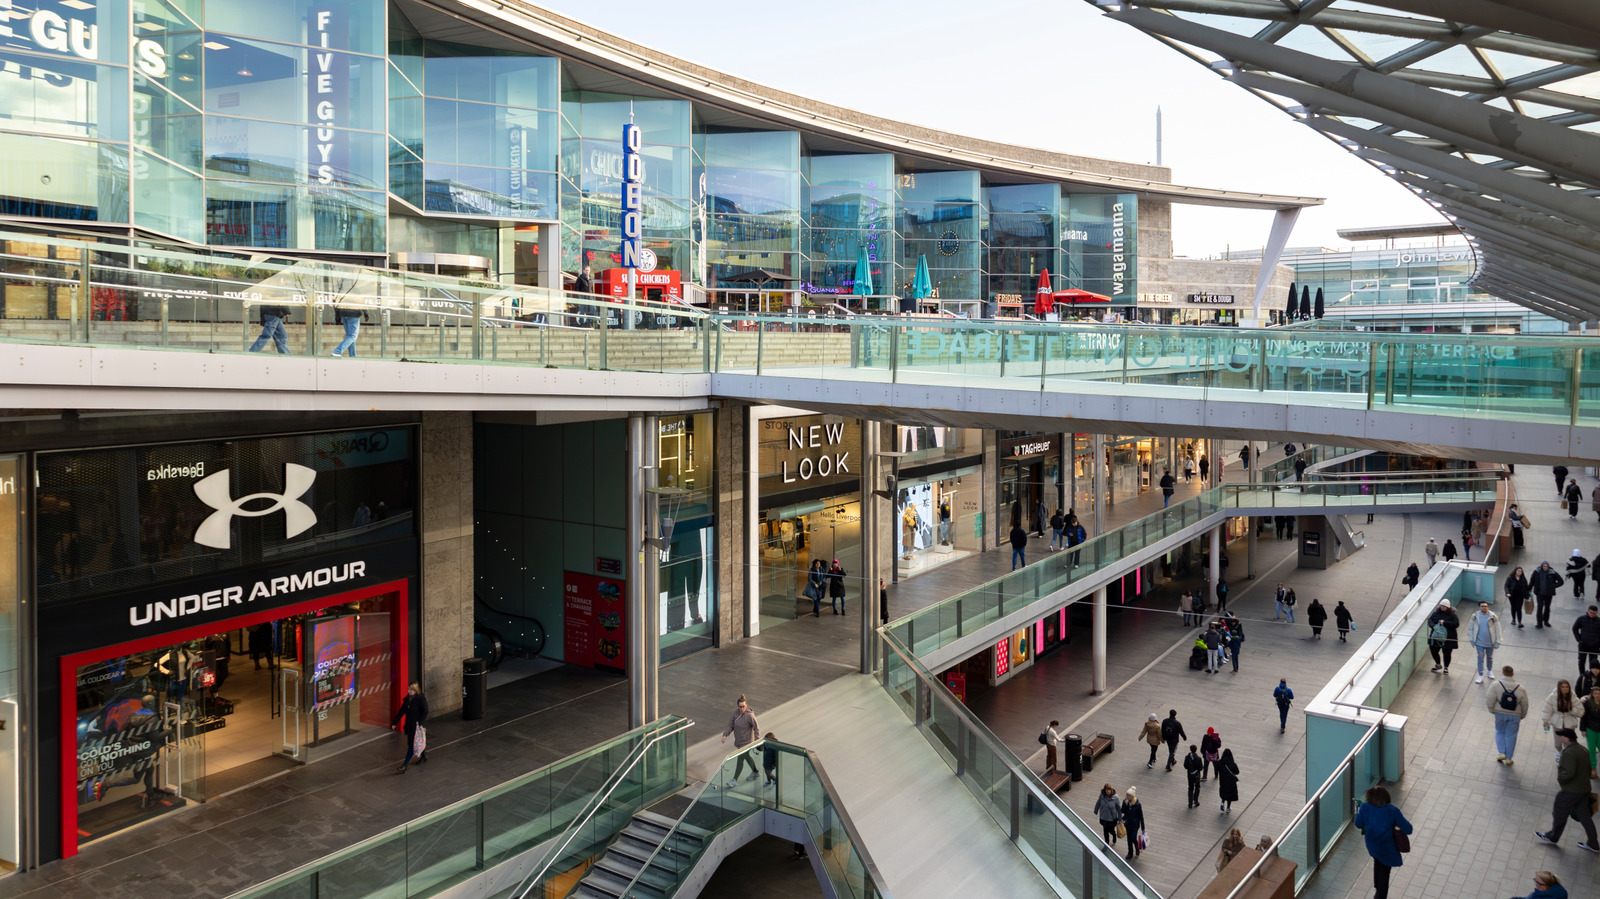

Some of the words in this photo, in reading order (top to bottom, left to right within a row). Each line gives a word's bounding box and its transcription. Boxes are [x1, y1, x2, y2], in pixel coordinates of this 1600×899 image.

[316, 11, 335, 93] FIVE
[316, 101, 336, 185] GUYS
[622, 124, 641, 268] ODEON
[1112, 202, 1126, 295] wagamama
[1396, 249, 1431, 267] John
[640, 274, 670, 284] CHICKENS
[1194, 294, 1213, 303] SMKE
[789, 422, 844, 451] NEW
[783, 451, 849, 484] LOOK
[129, 585, 243, 627] UNDER
[248, 560, 366, 602] ARMOUR
[80, 741, 122, 760] COLD'S
[80, 756, 98, 769] GOT
[101, 740, 151, 763] NOTHING
[80, 767, 94, 777] ON
[97, 760, 114, 772] YOU
